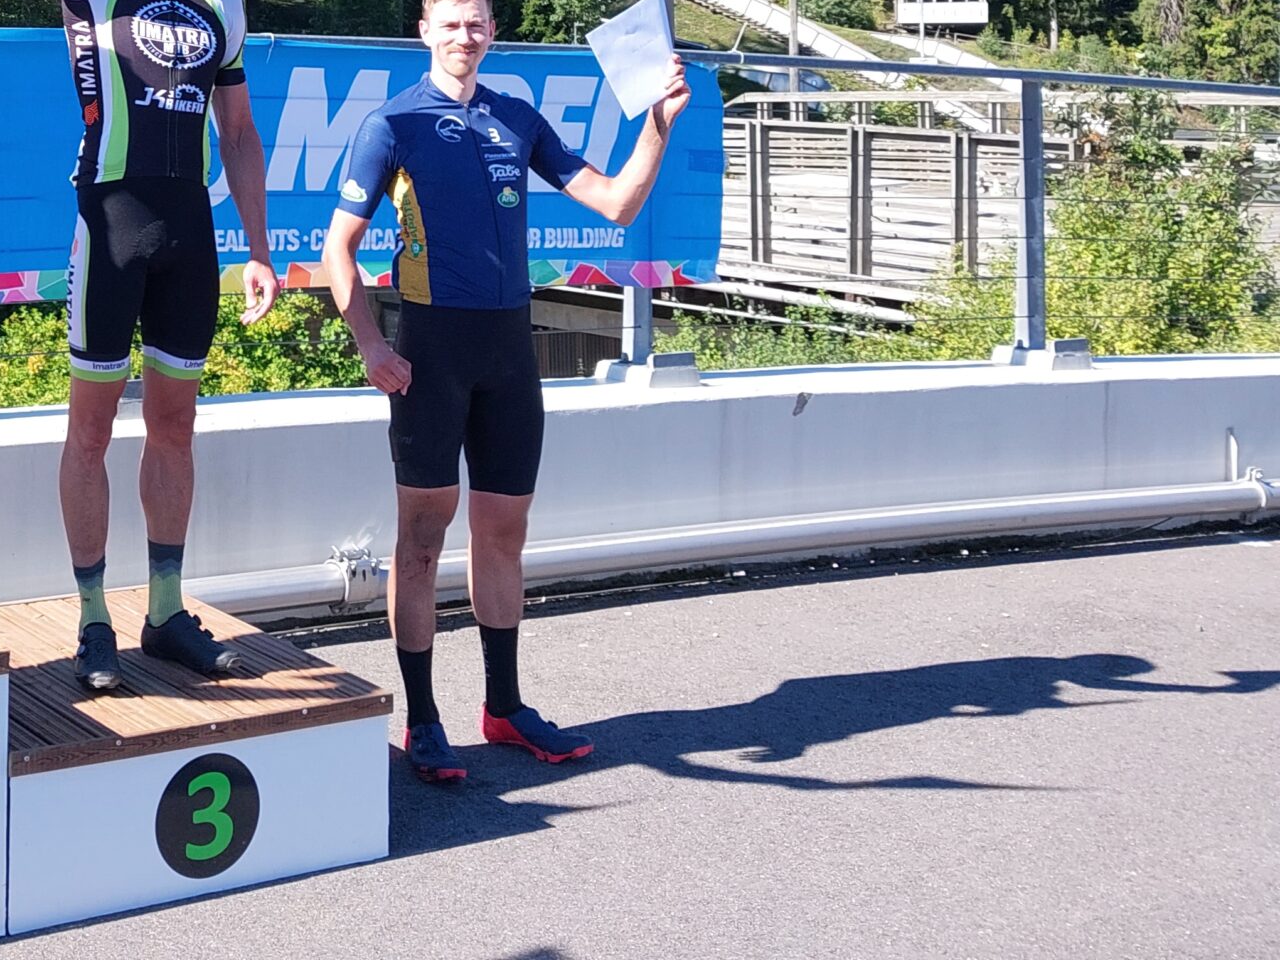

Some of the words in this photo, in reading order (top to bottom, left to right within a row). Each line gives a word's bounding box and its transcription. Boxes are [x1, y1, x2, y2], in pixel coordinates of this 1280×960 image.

[72, 20, 97, 96] IMATRA
[139, 20, 210, 50] IMATRA
[543, 226, 626, 250] BUILDING
[185, 771, 234, 861] 3
